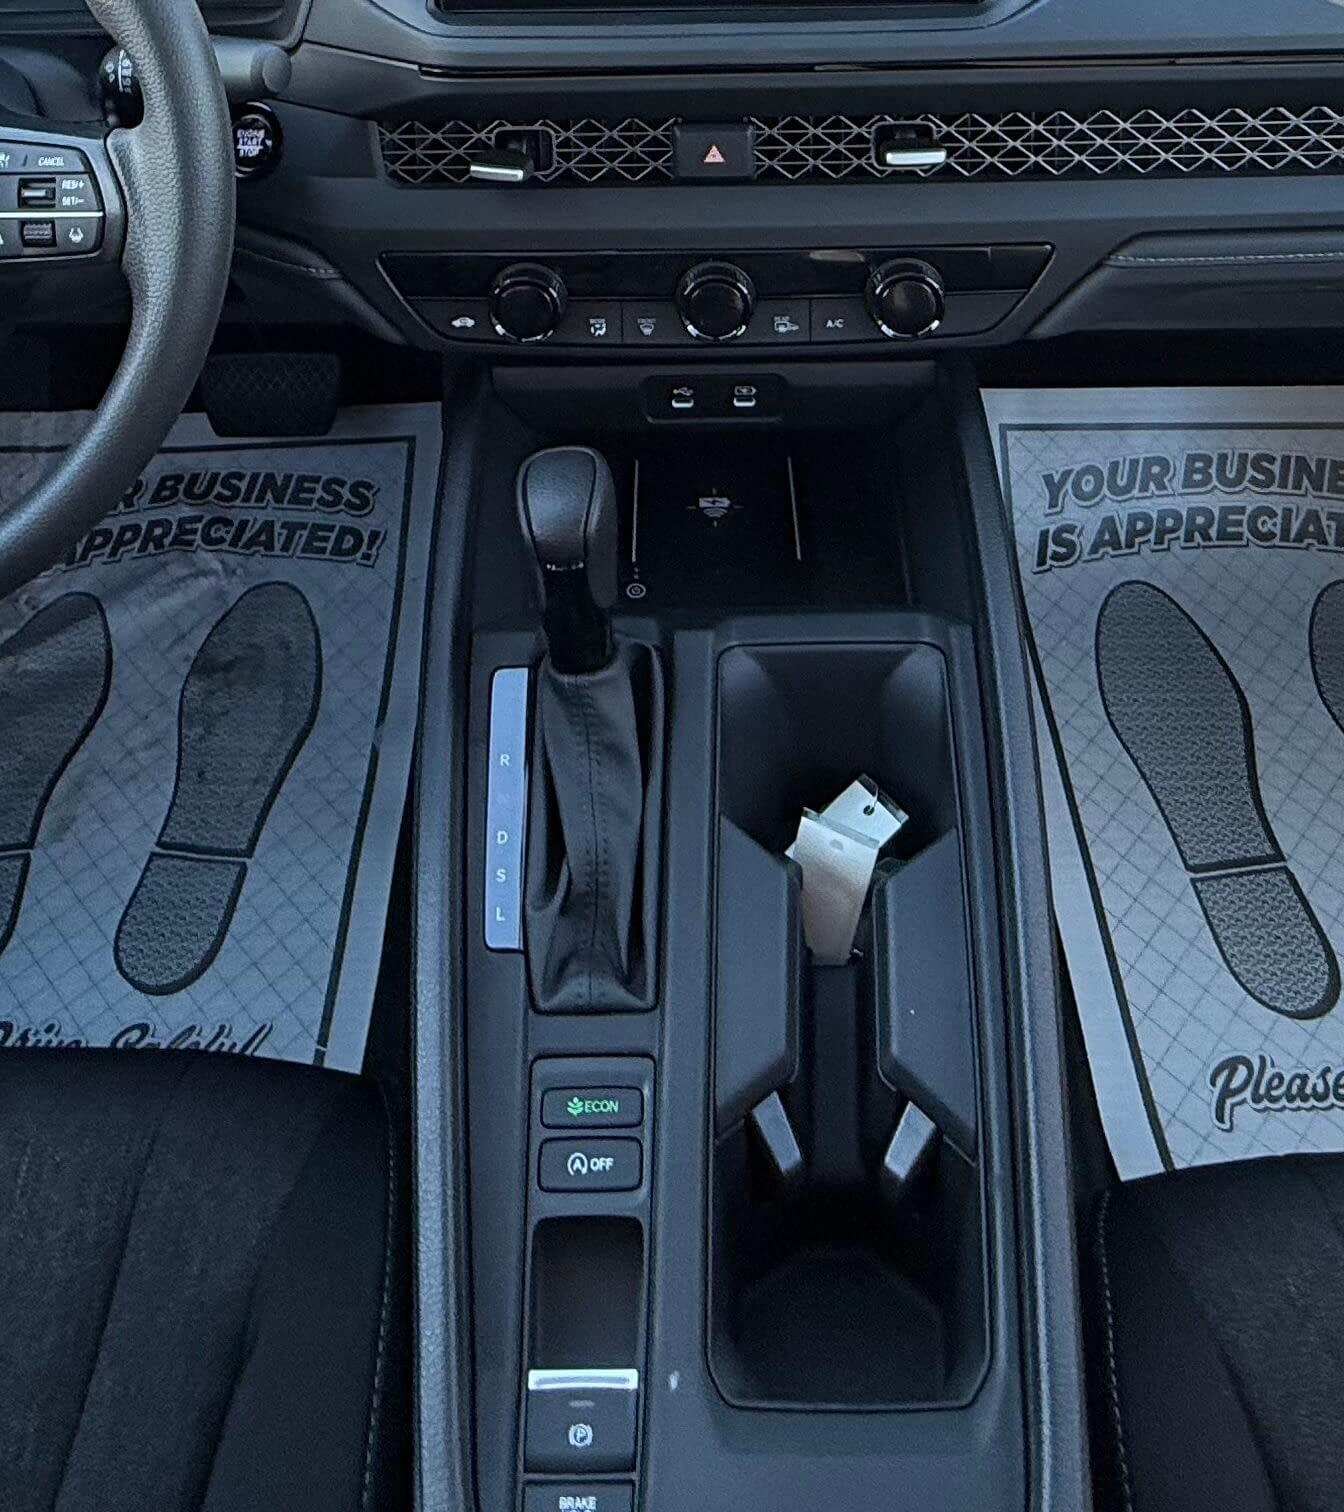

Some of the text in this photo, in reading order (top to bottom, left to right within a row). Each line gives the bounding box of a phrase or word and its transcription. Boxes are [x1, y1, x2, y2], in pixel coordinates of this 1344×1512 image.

[38, 156, 64, 167] CANCEL
[825, 318, 845, 329] A/C
[1041, 454, 1175, 512] YOUR
[147, 471, 378, 513] BUSINESS
[64, 515, 385, 567] PPRECIATED!
[1034, 523, 1081, 569] IS
[499, 753, 511, 767] R
[497, 830, 508, 844] D
[495, 868, 506, 883] S
[495, 906, 505, 920] L
[584, 1099, 619, 1113] ECON
[590, 1157, 614, 1171] OFF
[559, 1496, 597, 1510] BRAKE
